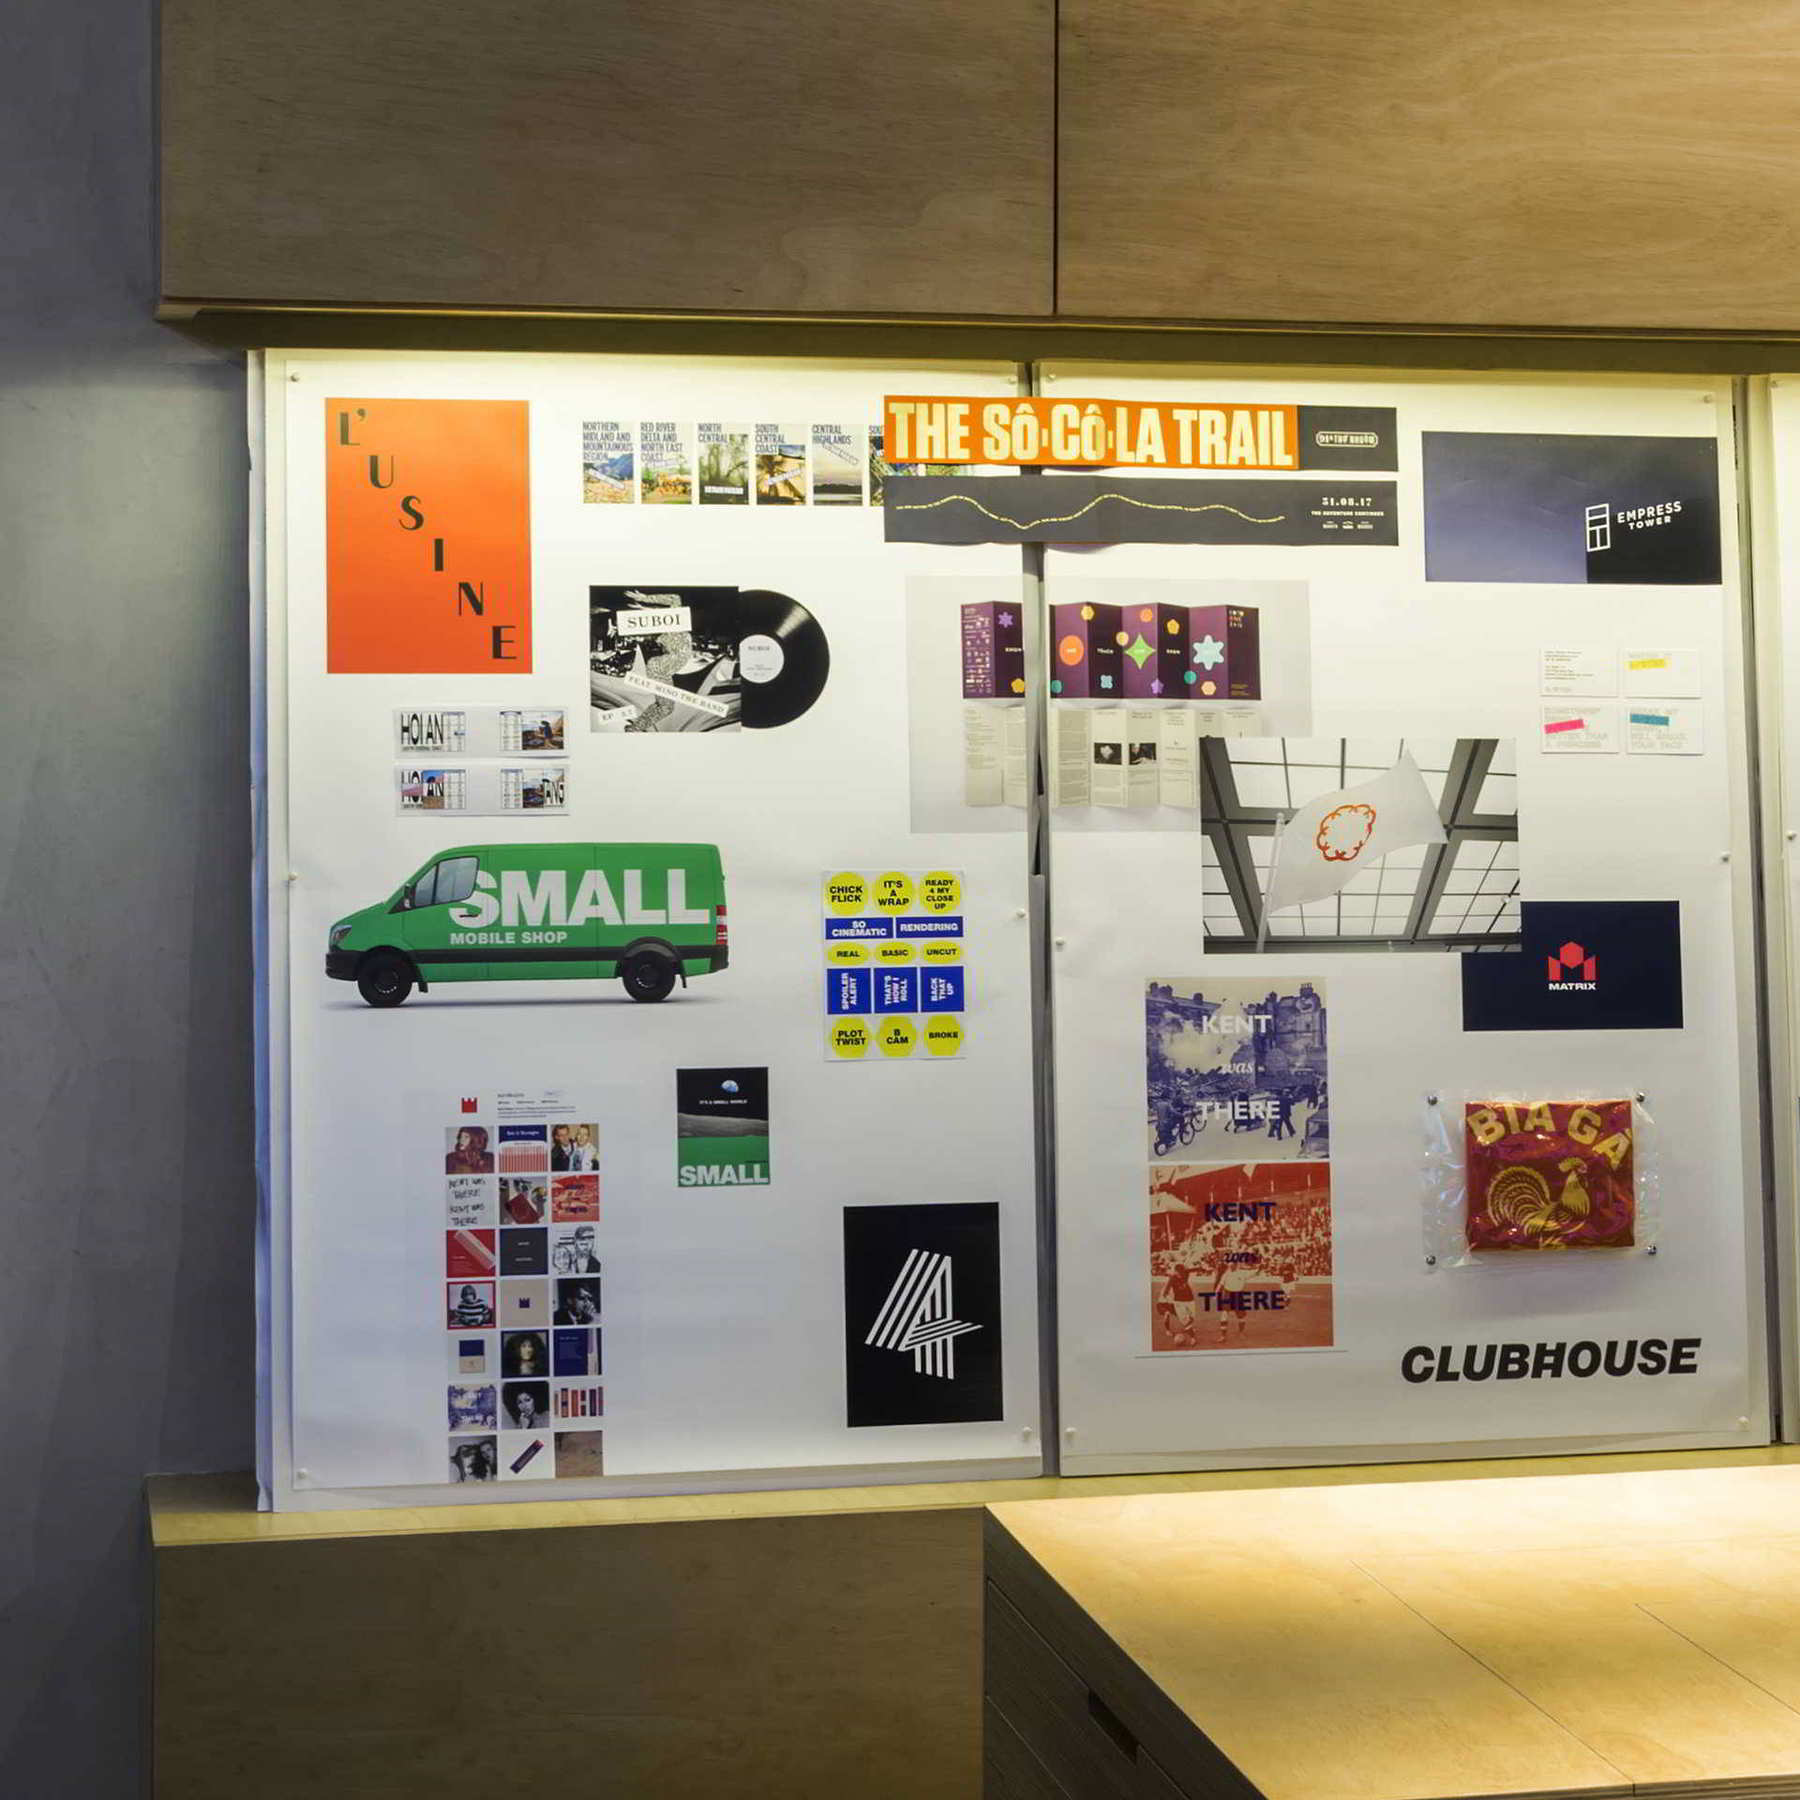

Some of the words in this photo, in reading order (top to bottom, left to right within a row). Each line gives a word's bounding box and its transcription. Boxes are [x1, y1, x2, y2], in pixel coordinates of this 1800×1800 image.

[583, 422, 619, 431] NORTHERN
[640, 422, 655, 432] RED
[656, 422, 675, 432] RIVER
[699, 423, 722, 432] NORTH
[755, 424, 779, 433] SOUTH
[812, 424, 841, 434] CENTRAL
[663, 432, 677, 442] AND
[699, 433, 728, 443] CENTRAL
[755, 434, 784, 444] CENTRAL
[889, 402, 970, 460] THE
[1172, 409, 1293, 466] TRAIL
[812, 435, 851, 445] HIGHLANDS
[641, 443, 664, 452] NORTH
[666, 443, 683, 452] EAST
[755, 444, 778, 453] COAST
[1617, 501, 1682, 523] EMPRESS
[1628, 516, 1671, 530] TOWER
[628, 614, 680, 628] SUBOI
[401, 712, 423, 745] HOI
[425, 713, 444, 745] AN
[884, 880, 903, 888] IT'S
[830, 886, 862, 894] CHICK
[890, 889, 897, 897] A
[448, 868, 710, 929] SMALL
[831, 894, 862, 903] FLICK
[878, 898, 909, 906] WRAP
[832, 928, 887, 936] CINEMATIC
[900, 923, 958, 931] RENDERING
[450, 931, 515, 945] MOBILE
[521, 931, 567, 944] SHOP
[841, 973, 849, 1010] SPOILER
[892, 982, 900, 1003] HOW
[930, 977, 938, 1001] BACK
[947, 983, 954, 995] UP
[1202, 1014, 1272, 1034] KENT
[836, 1038, 866, 1046] TWIST
[887, 1036, 908, 1044] CAM
[1220, 1060, 1253, 1075] was
[1196, 1100, 1280, 1121] THERE
[1467, 1102, 1555, 1146] BIA
[680, 1163, 769, 1186] SMALL
[1204, 1202, 1277, 1222] KENT
[1223, 1251, 1257, 1264] was
[1199, 1291, 1285, 1312] THERE
[1401, 1338, 1702, 1384] CLUBHOUSE
